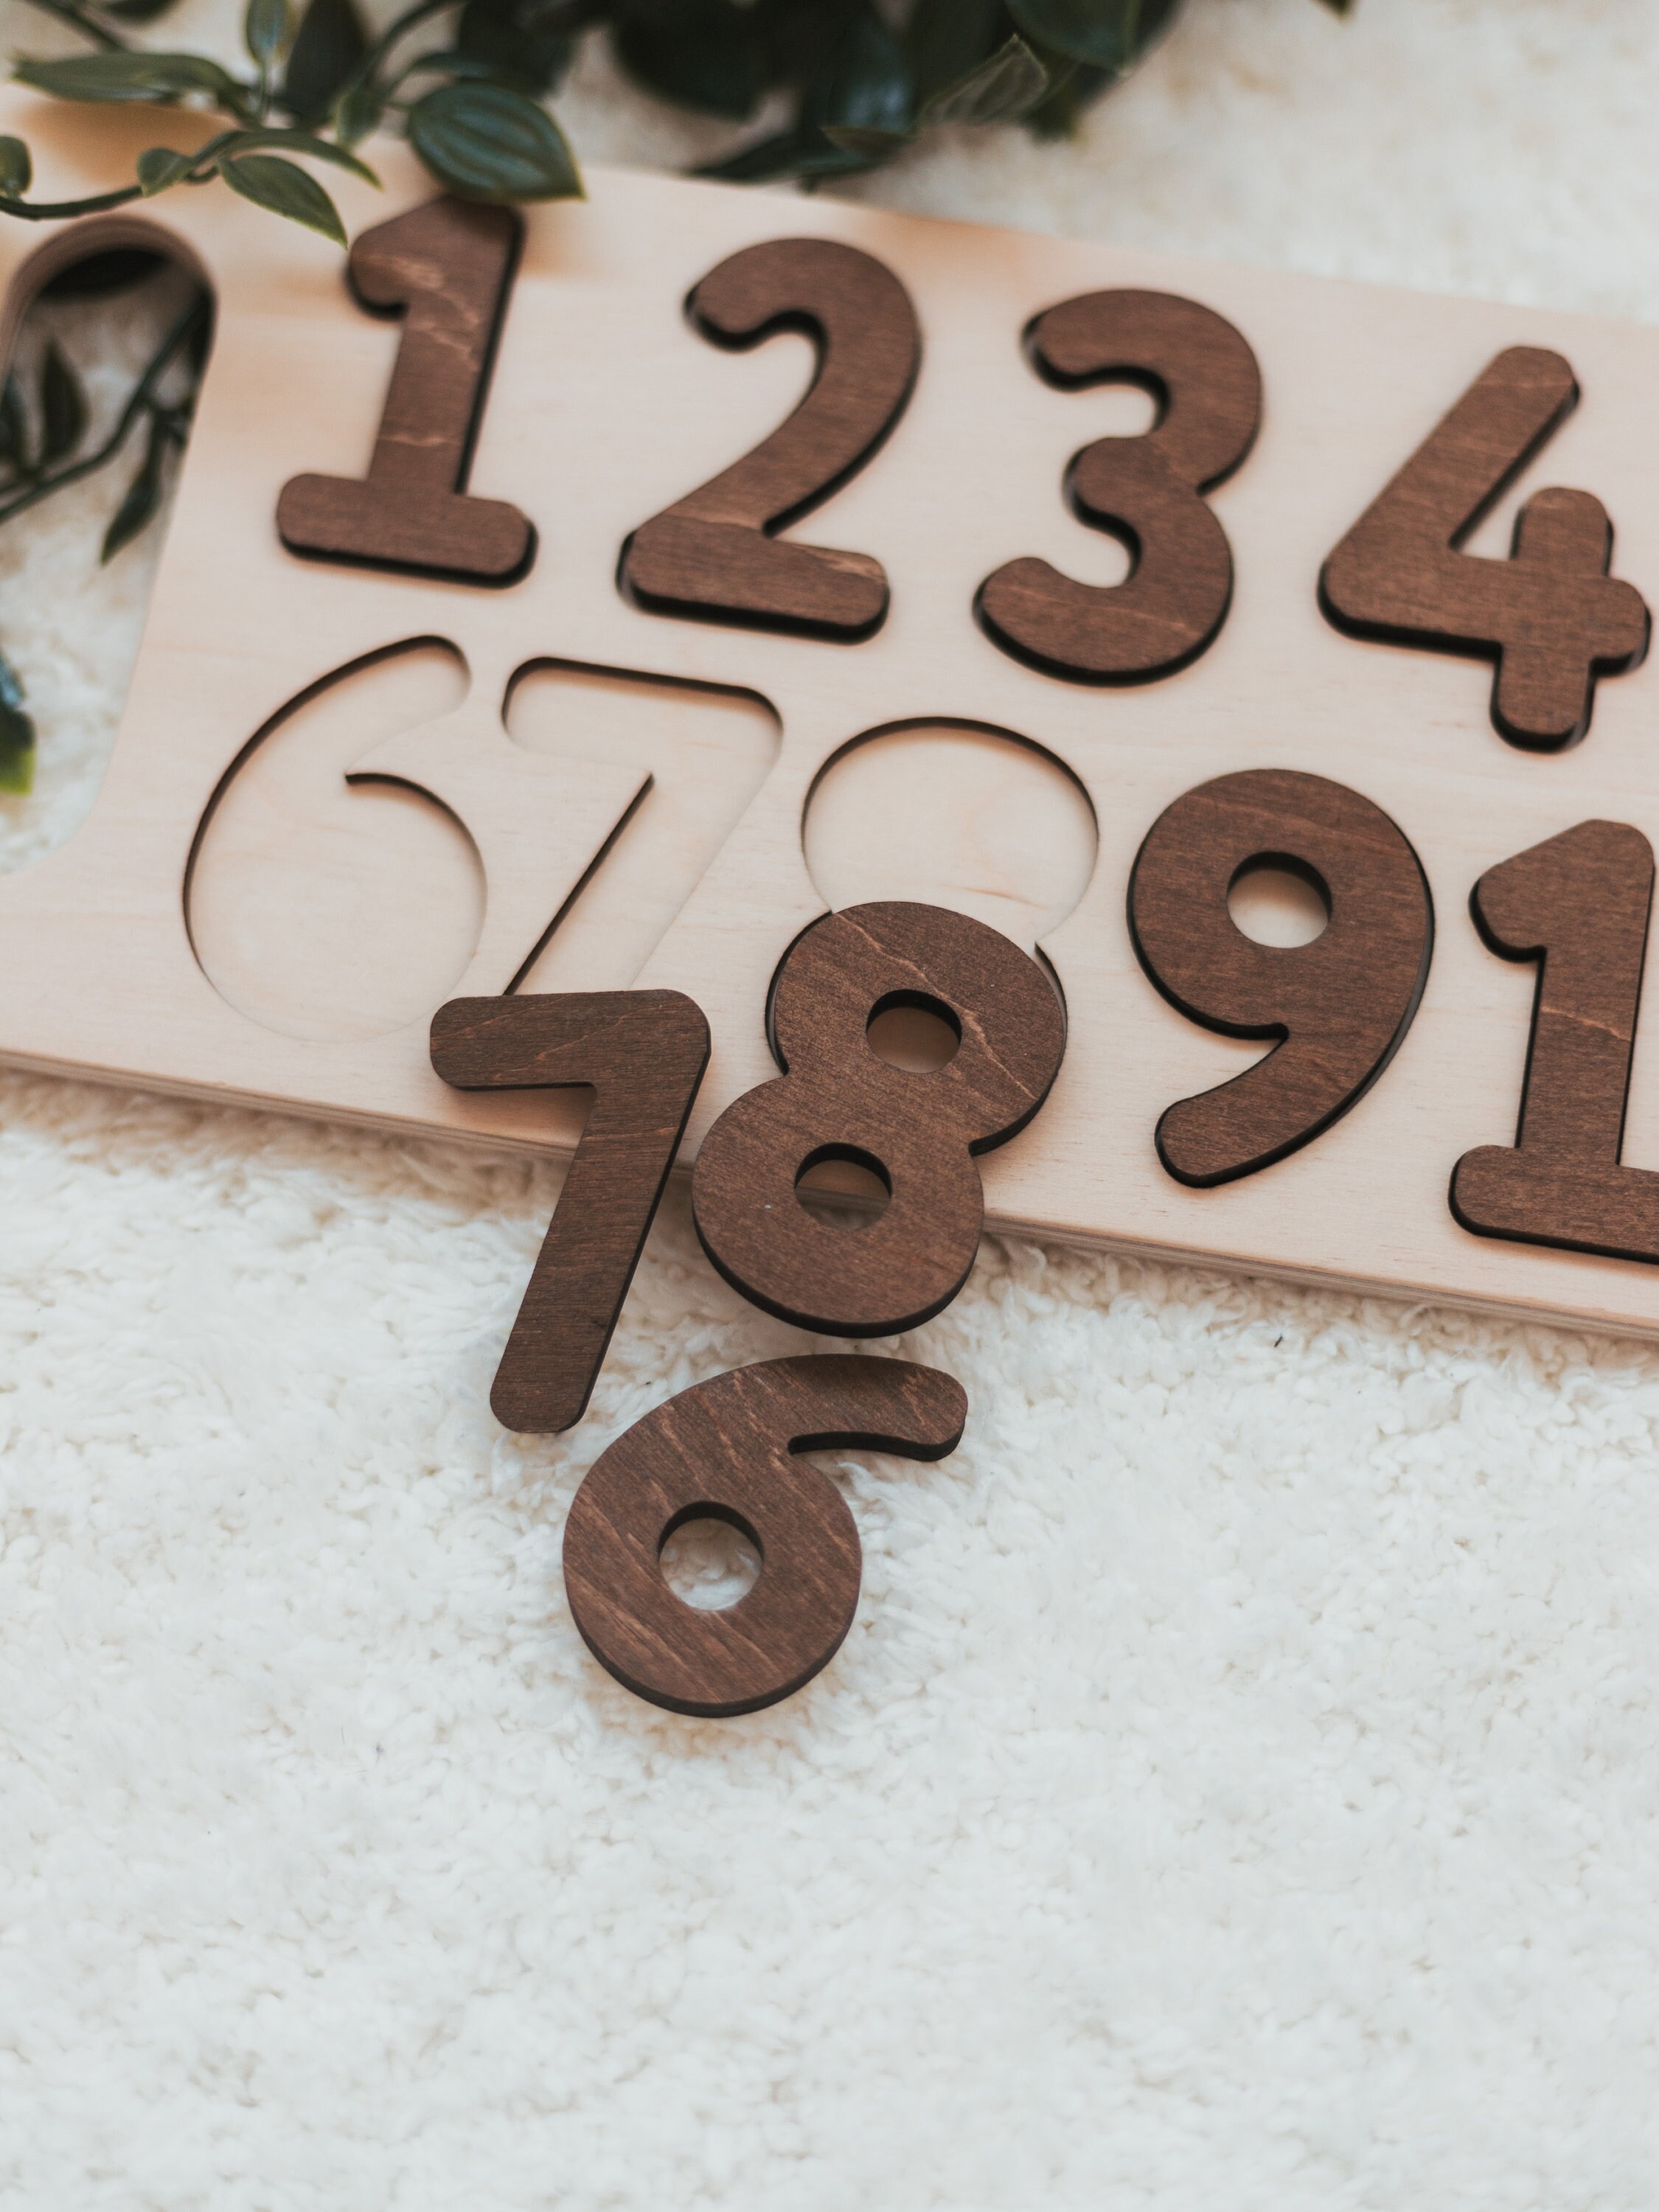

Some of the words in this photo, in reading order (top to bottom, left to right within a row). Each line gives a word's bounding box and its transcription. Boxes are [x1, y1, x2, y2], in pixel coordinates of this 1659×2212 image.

[276, 195, 539, 588] 1
[615, 237, 924, 646] 2
[972, 288, 1264, 689] 3
[1316, 345, 1652, 756] 4
[183, 634, 485, 1043] 6
[502, 655, 785, 998] 7
[1126, 768, 1435, 1189] 9
[1449, 818, 1659, 1265] 1
[430, 989, 711, 1433] 7
[692, 901, 1067, 1338] 8
[563, 1354, 969, 1719] 6
